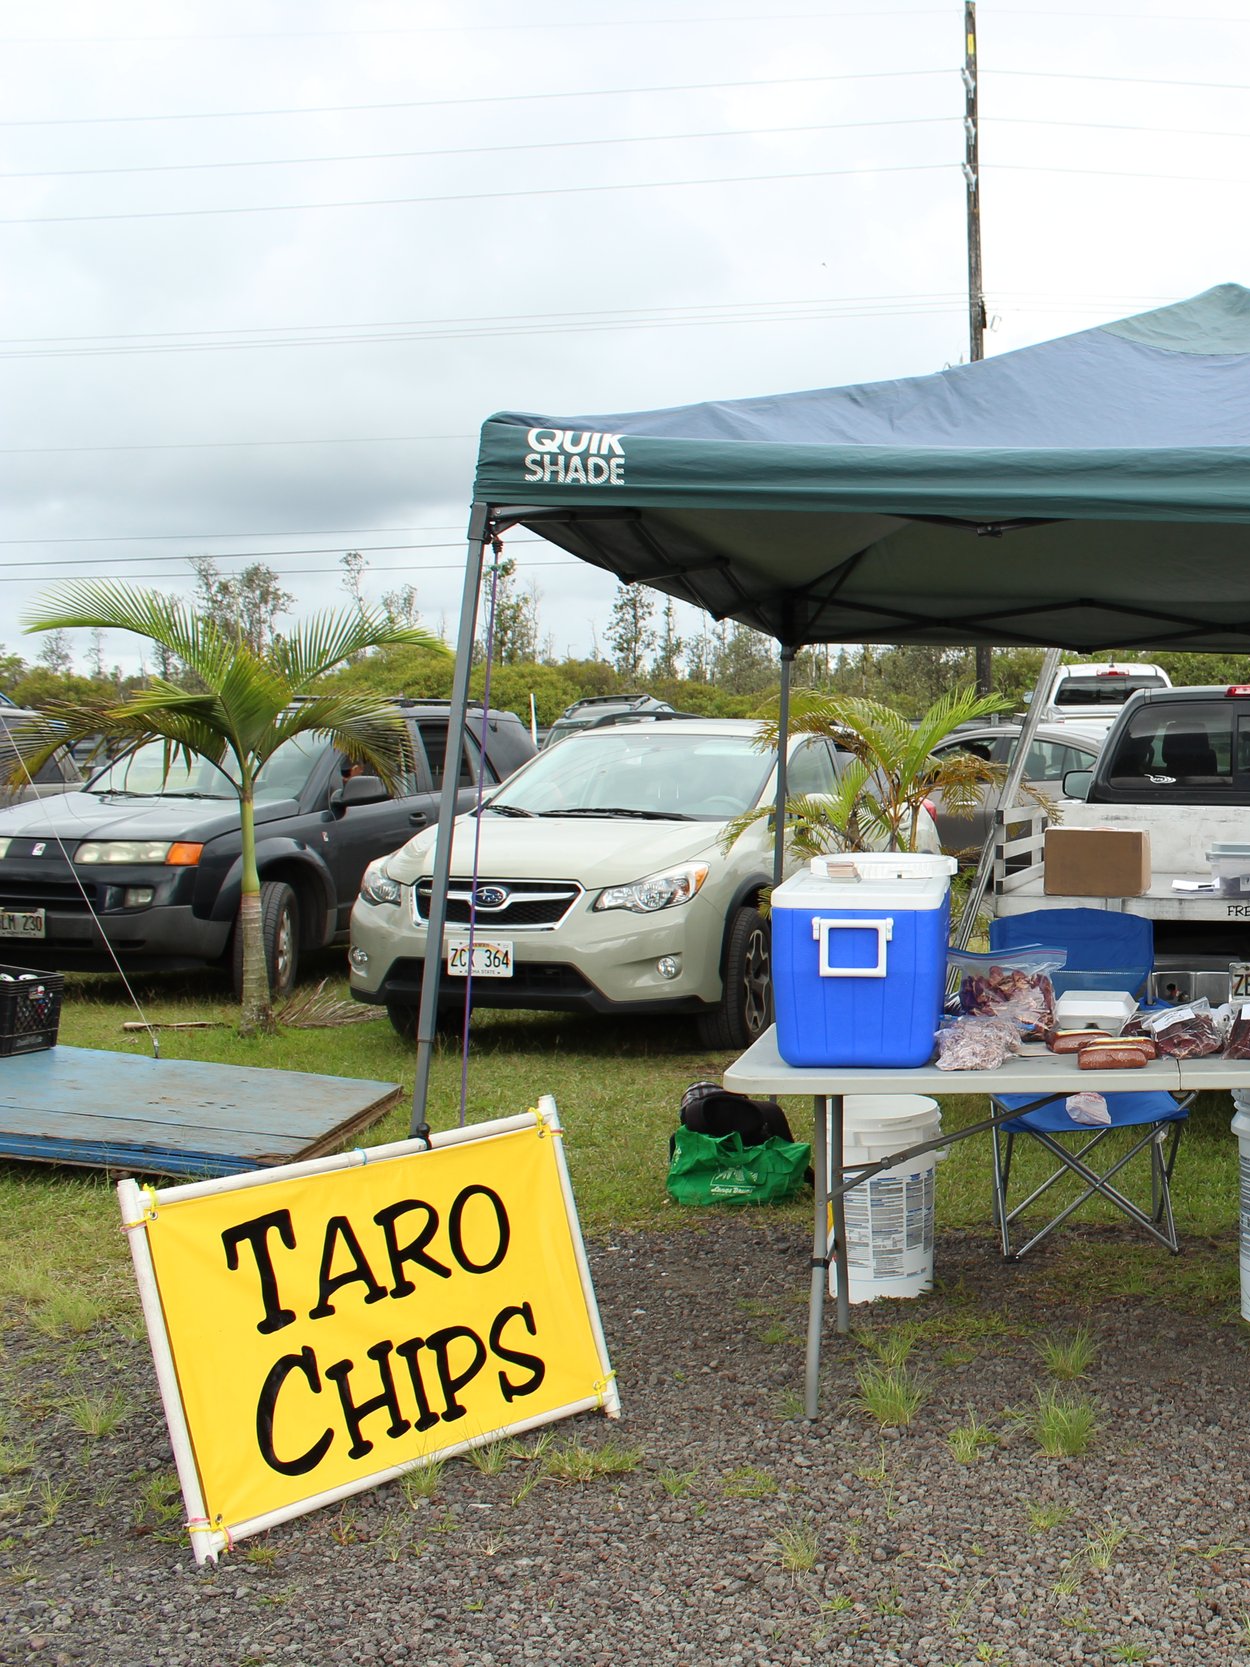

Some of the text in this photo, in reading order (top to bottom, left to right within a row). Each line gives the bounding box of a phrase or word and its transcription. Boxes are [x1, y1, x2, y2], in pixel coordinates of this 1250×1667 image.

[527, 428, 629, 456] QUIK
[524, 453, 626, 485] SHADE
[22, 915, 42, 932] 230
[484, 949, 510, 968] 364
[221, 1184, 510, 1335] TARO
[256, 1301, 546, 1476] CHIPS
